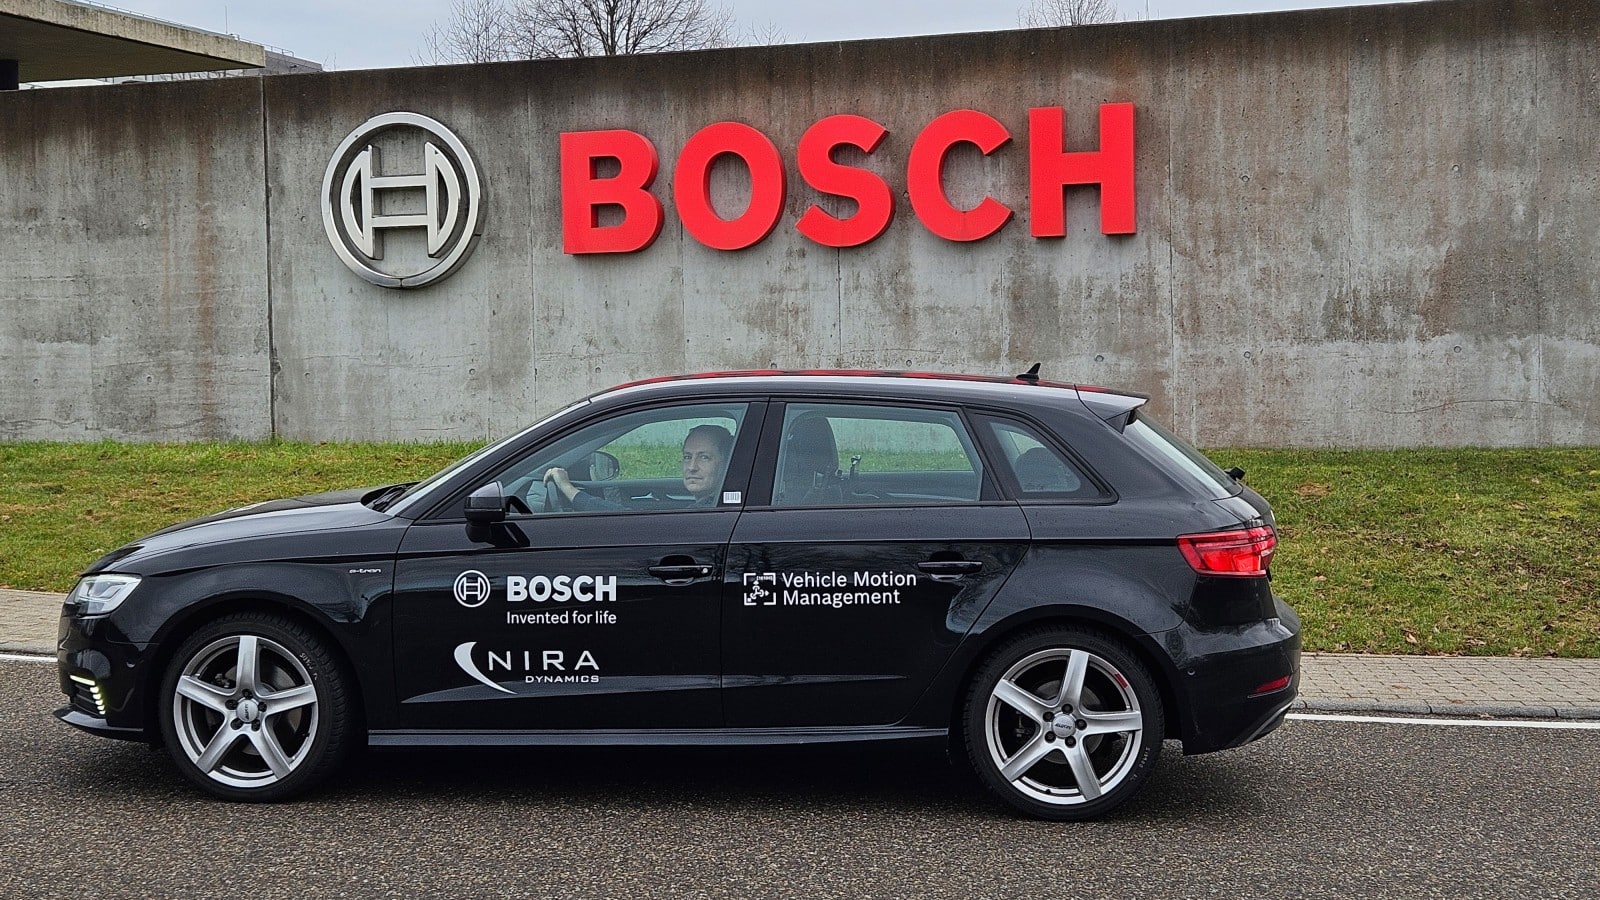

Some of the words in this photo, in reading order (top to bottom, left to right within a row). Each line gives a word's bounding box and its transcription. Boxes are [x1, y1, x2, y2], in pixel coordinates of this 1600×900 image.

[560, 102, 1137, 255] BOSCH
[507, 575, 617, 602] BOSCH
[782, 572, 848, 588] Vehicle
[854, 571, 917, 587] Motion
[783, 589, 901, 609] Management
[507, 611, 569, 624] Invented
[572, 611, 592, 624] for
[595, 611, 617, 624] life
[488, 650, 600, 671] NIRA
[525, 675, 600, 683] DYNAMICS
